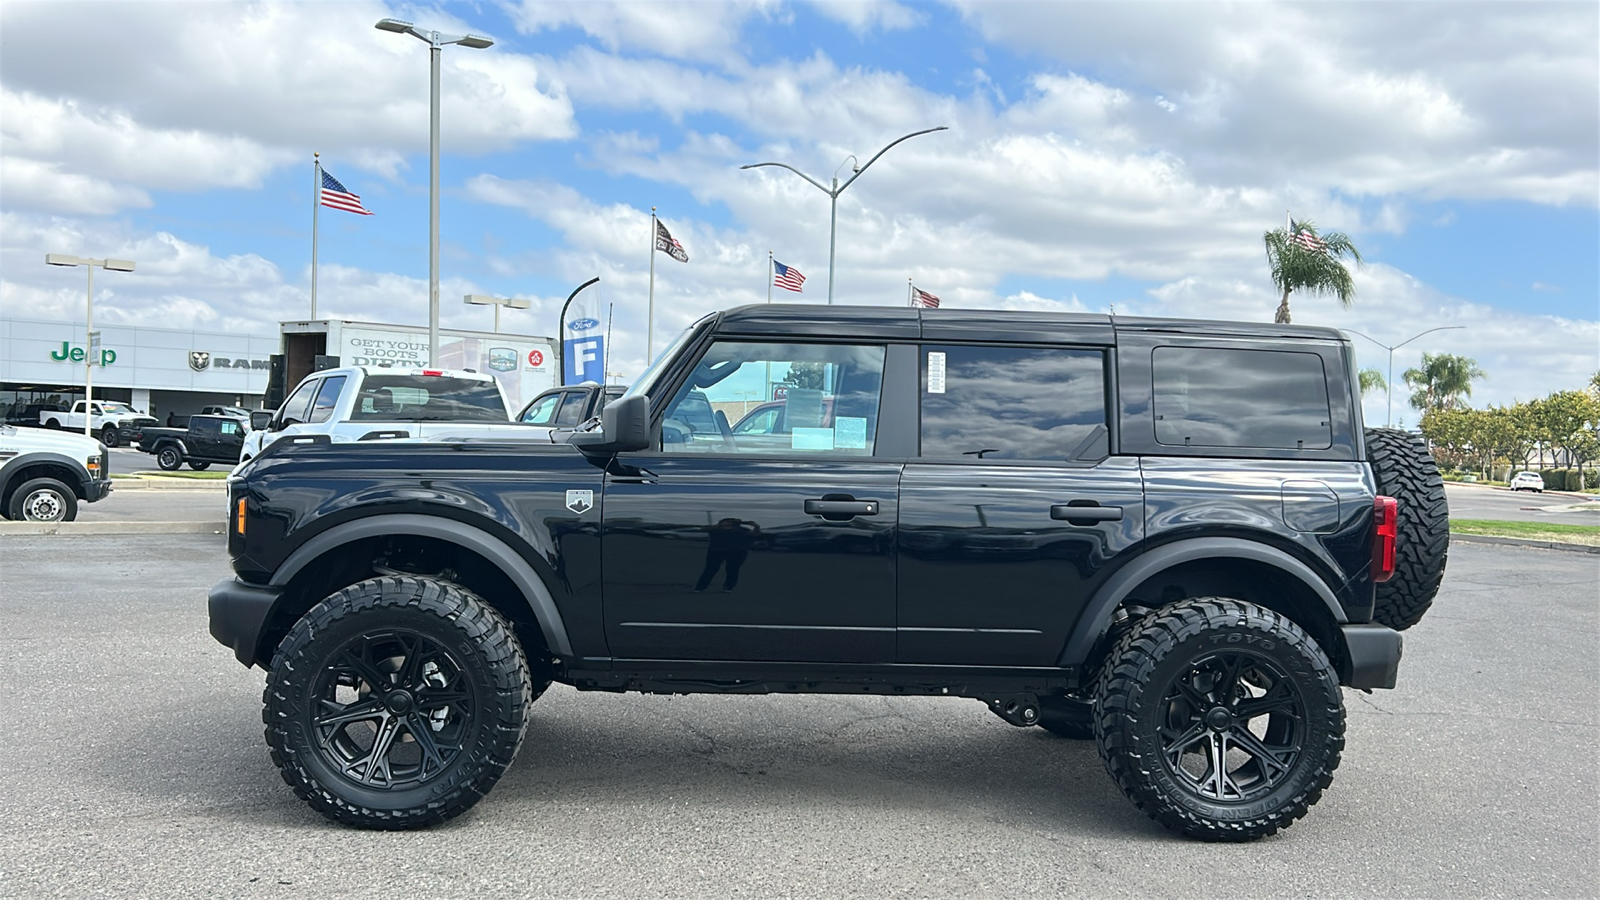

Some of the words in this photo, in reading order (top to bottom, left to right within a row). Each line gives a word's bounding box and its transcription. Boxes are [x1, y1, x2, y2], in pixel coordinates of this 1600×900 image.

[573, 319, 593, 331] Ford
[350, 338, 384, 348] GET
[387, 341, 430, 351] YOUR
[51, 341, 117, 367] Jep
[363, 348, 418, 359] BOOTS
[213, 357, 270, 370] RAM
[1209, 632, 1276, 652] TOYO
